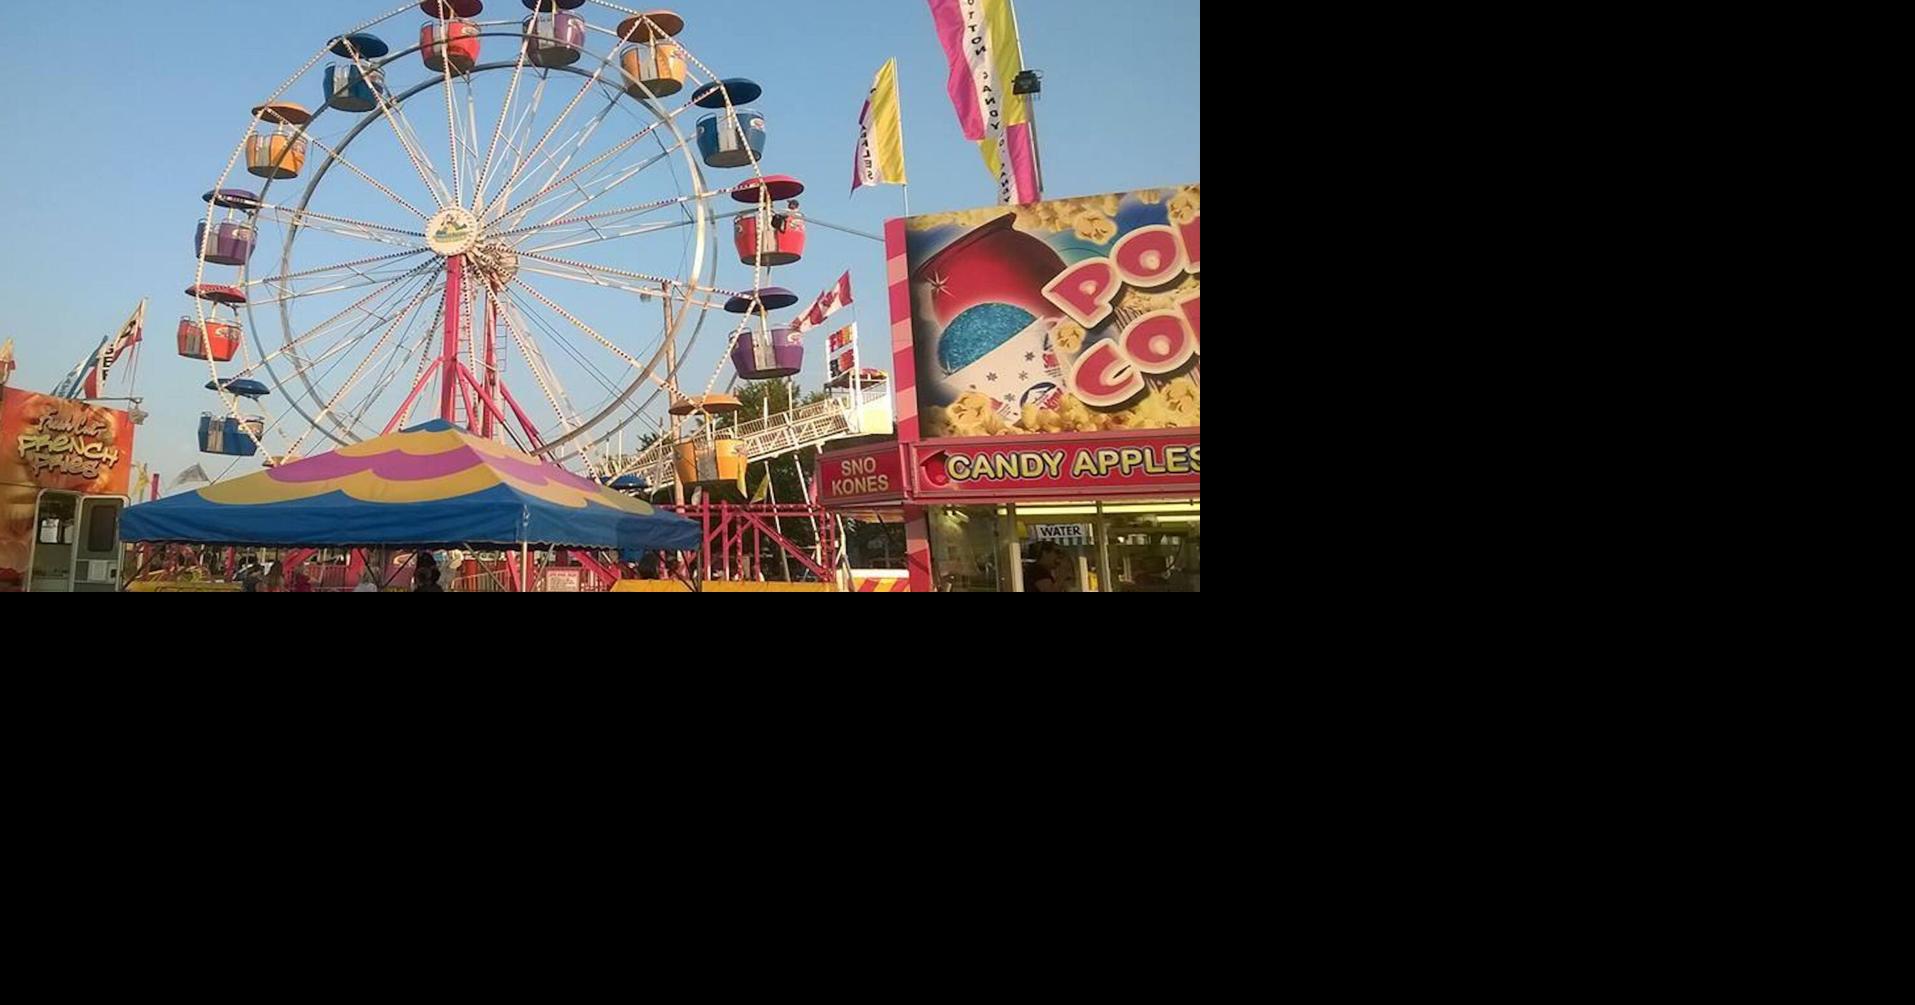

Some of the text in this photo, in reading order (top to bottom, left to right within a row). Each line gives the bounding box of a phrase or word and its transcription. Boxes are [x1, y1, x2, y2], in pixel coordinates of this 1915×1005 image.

[840, 456, 876, 476] SNO
[946, 450, 1065, 482] CANDY
[831, 473, 889, 496] KONES
[1040, 525, 1082, 538] WATER
